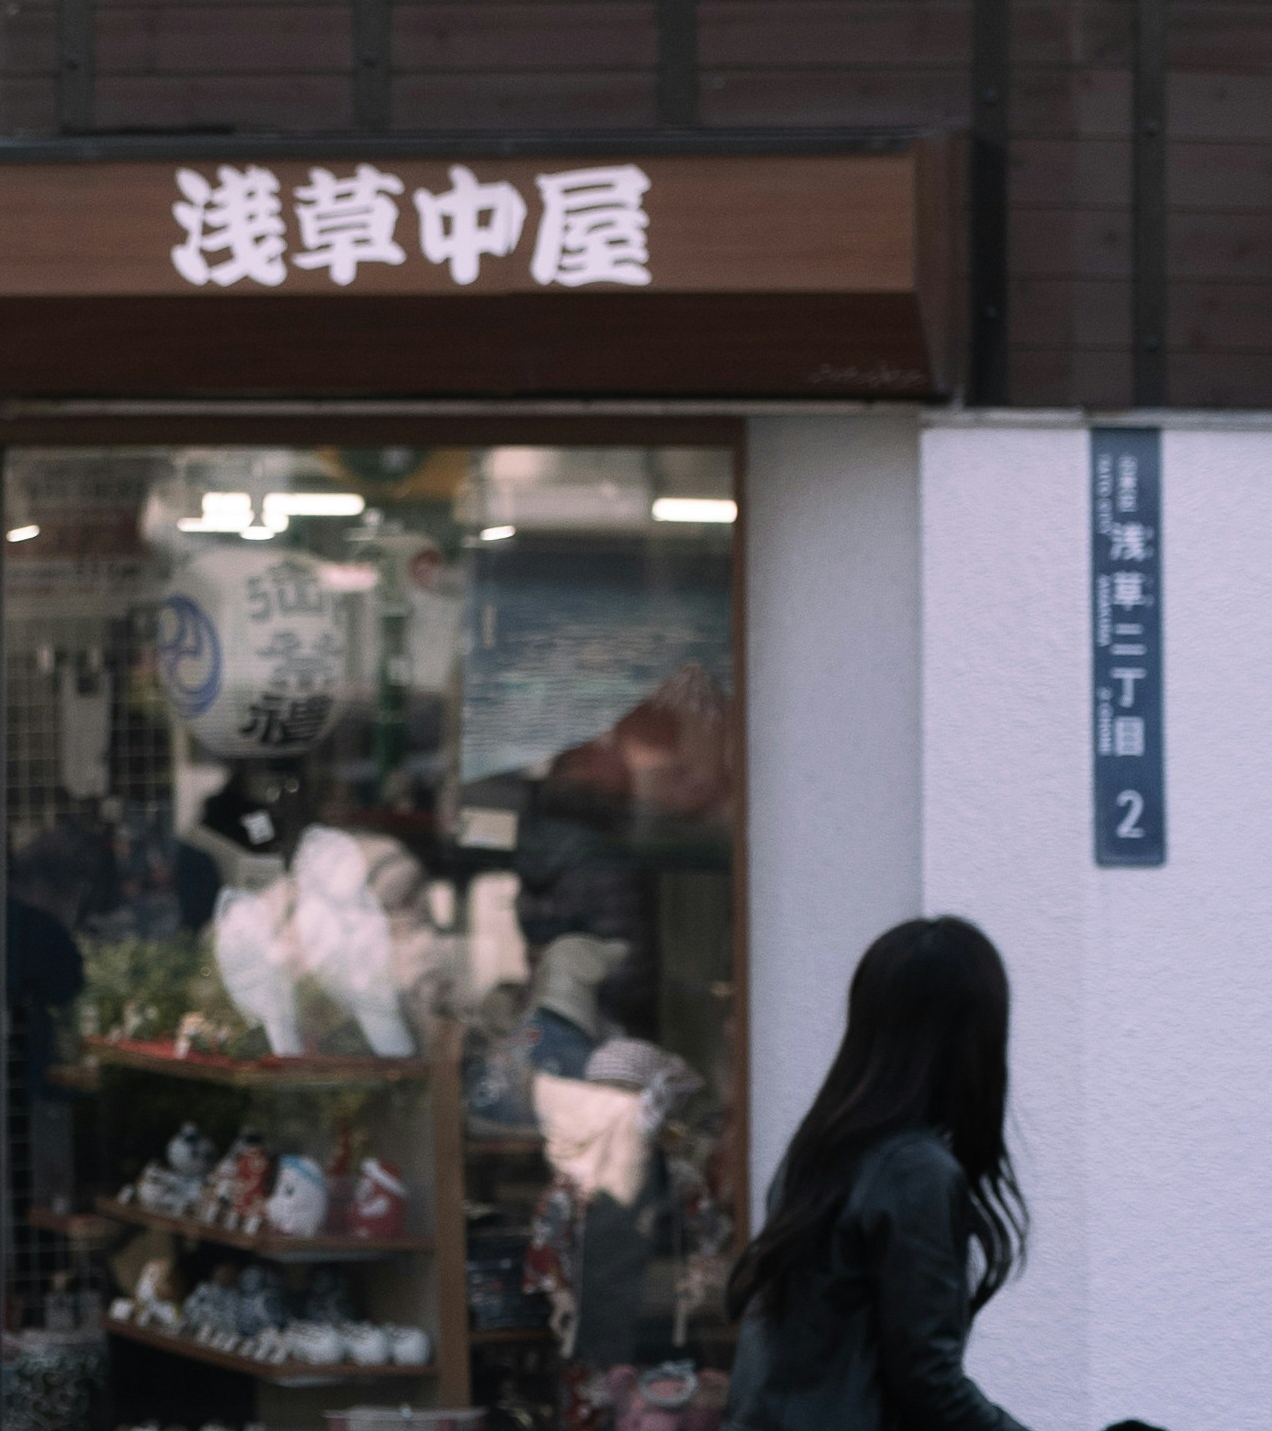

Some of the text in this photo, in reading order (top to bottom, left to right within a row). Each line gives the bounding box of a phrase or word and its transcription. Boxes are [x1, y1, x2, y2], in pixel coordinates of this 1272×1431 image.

[170, 163, 652, 287] 浅草中屋
[1109, 522, 1147, 757] 浅草二丁目
[1116, 789, 1145, 838] 2
